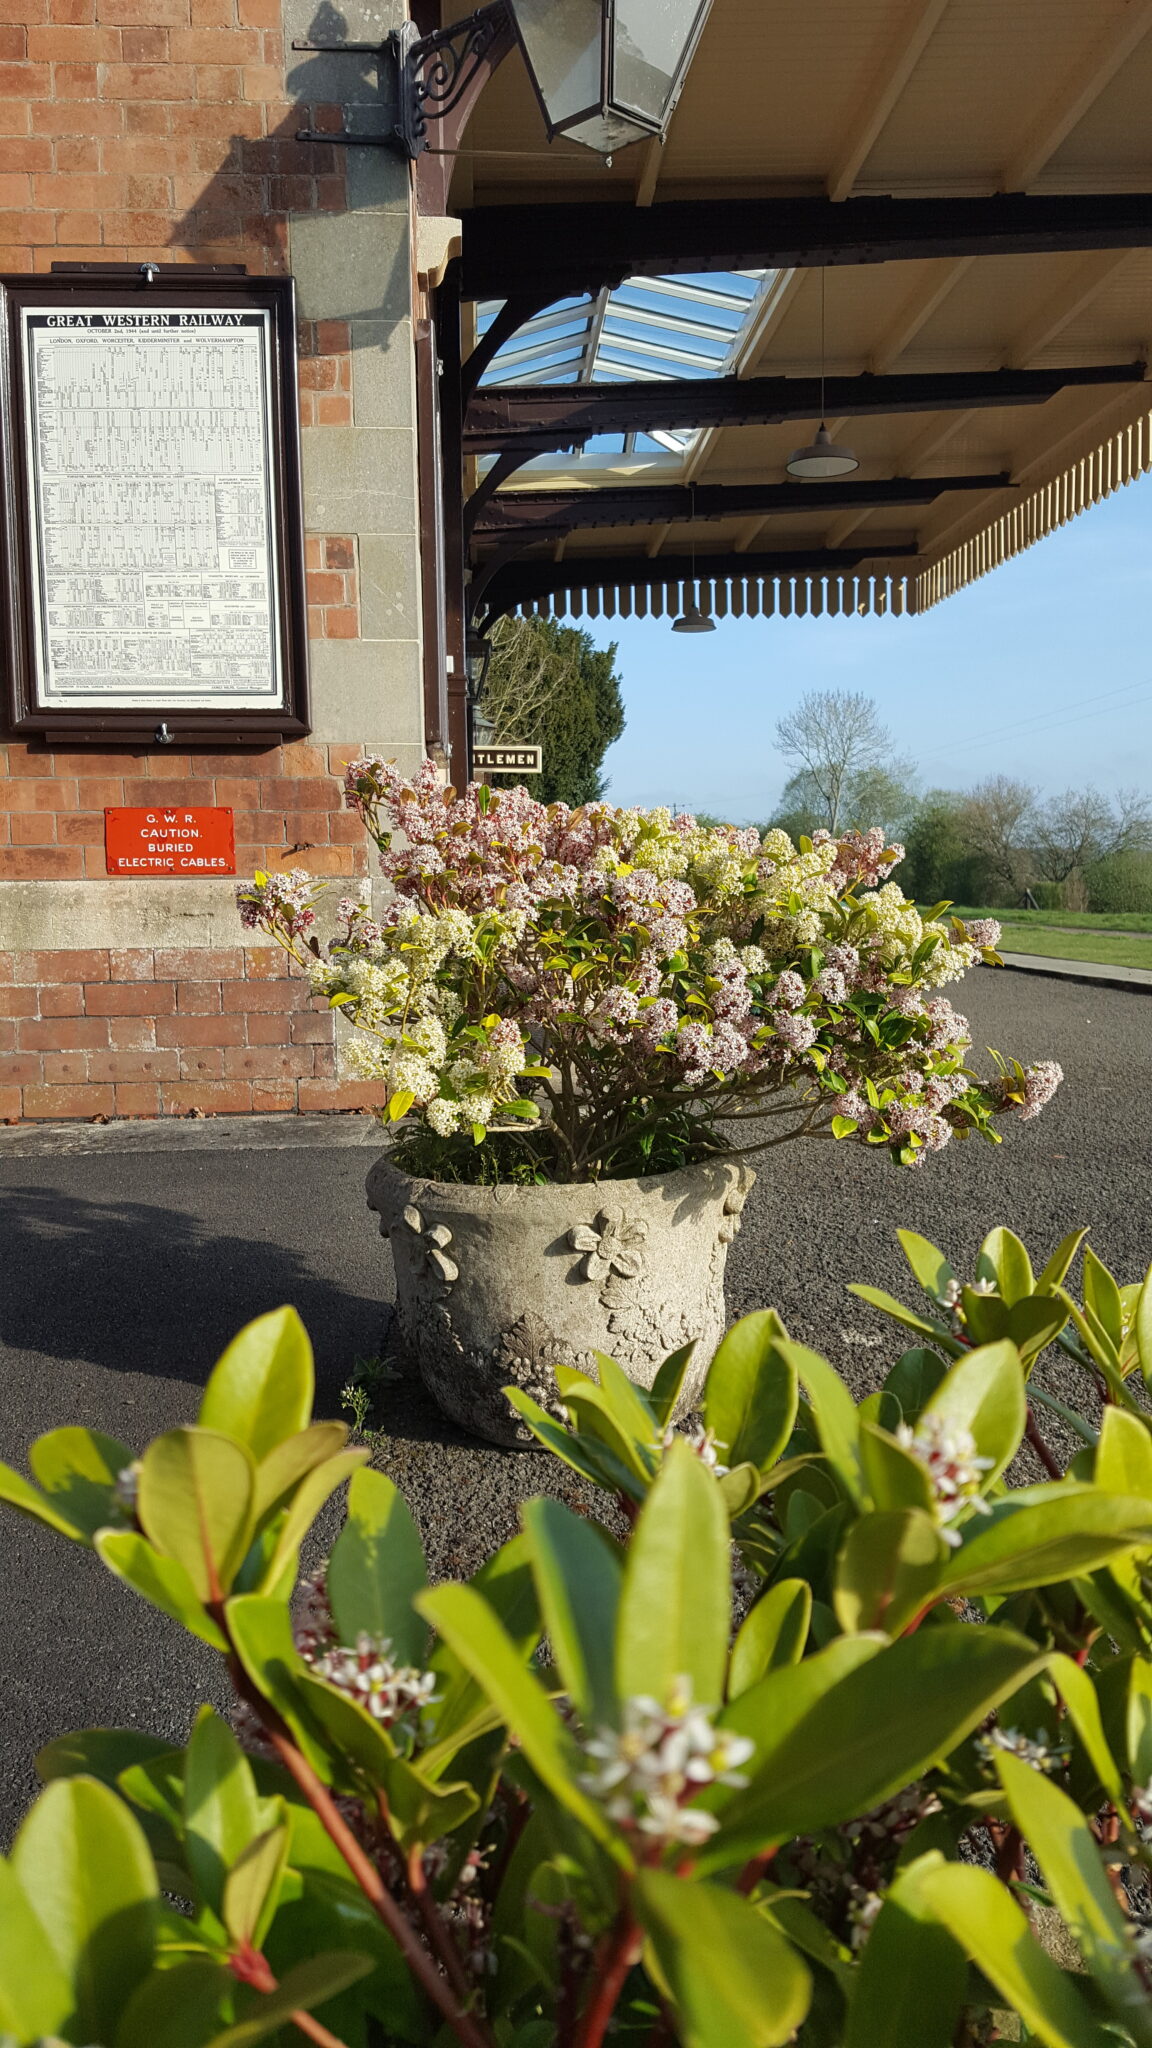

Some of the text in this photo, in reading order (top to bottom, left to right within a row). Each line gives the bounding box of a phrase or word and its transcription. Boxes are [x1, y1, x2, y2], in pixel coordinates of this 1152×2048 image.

[46, 315, 93, 327] GREAT
[102, 314, 170, 327] WESTERN
[146, 814, 197, 823] G. W. R.
[140, 829, 203, 838] CAUTION.
[148, 843, 193, 852] BURIED
[118, 858, 229, 867] ELECTRIC CABLES.
